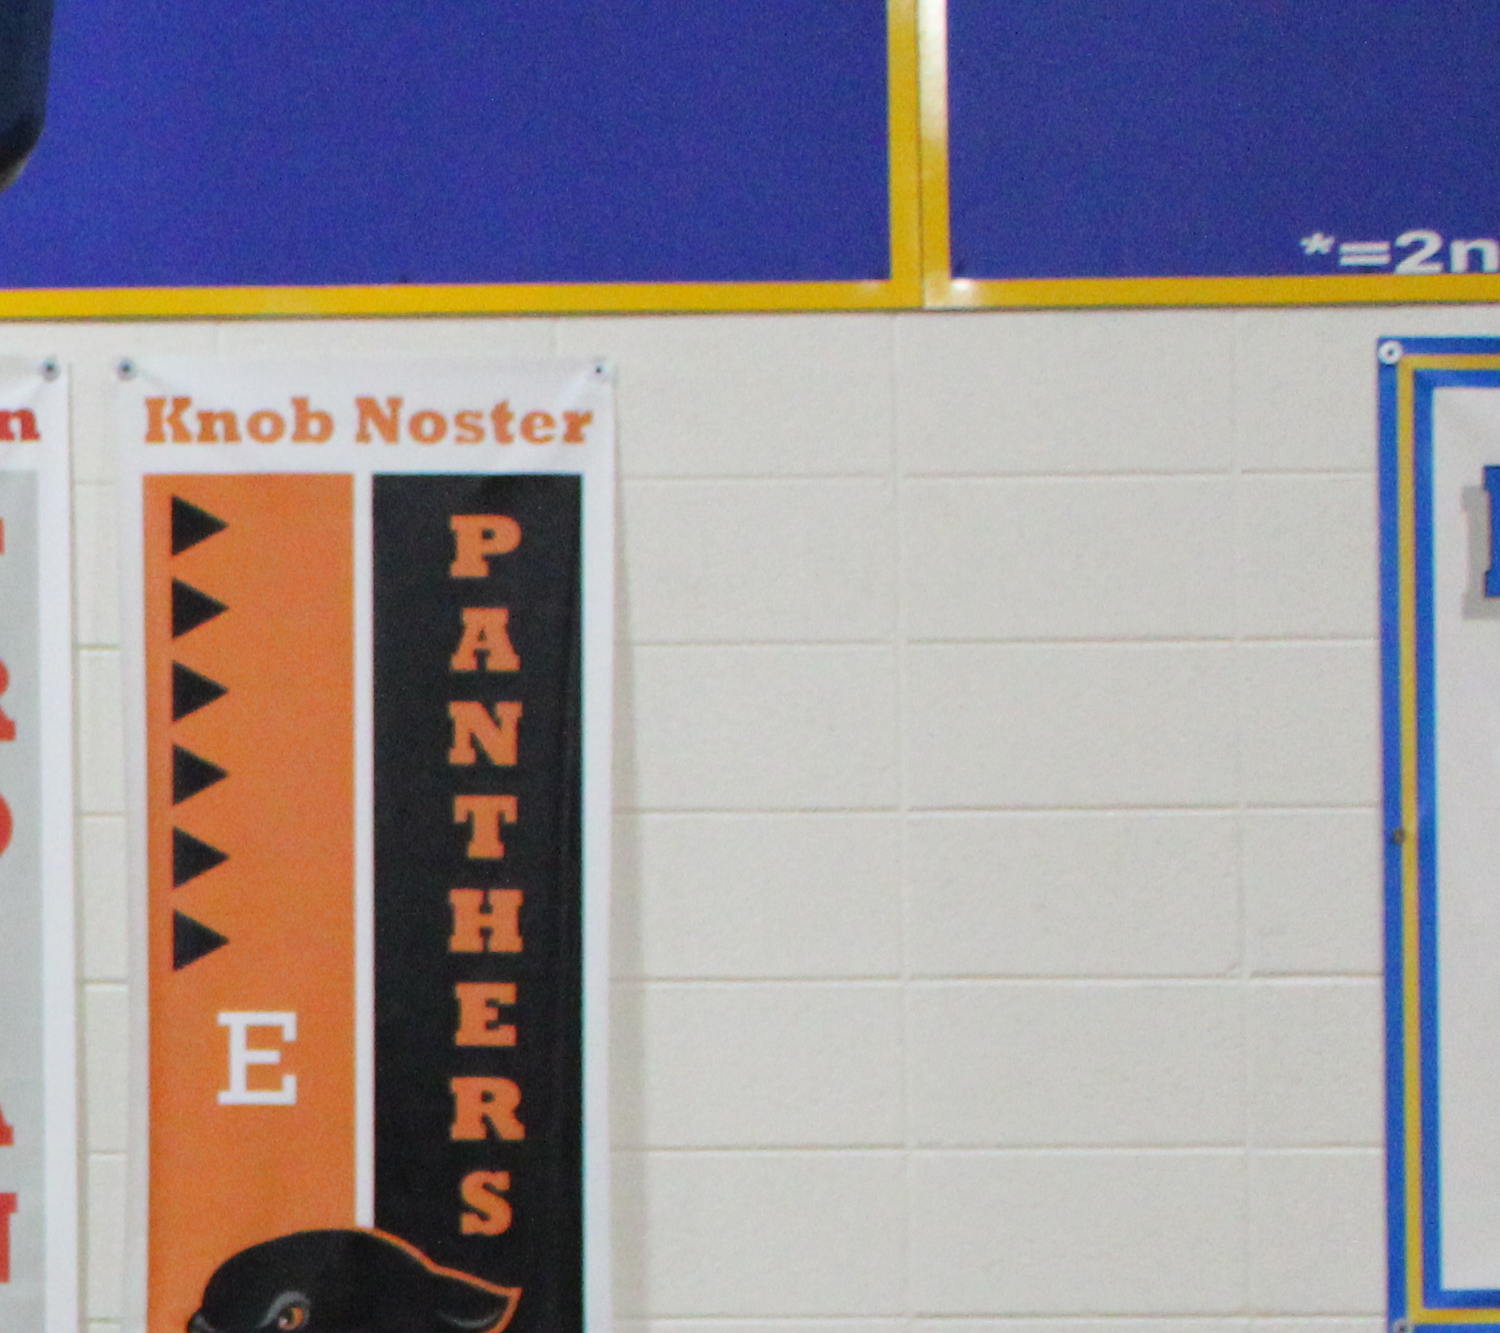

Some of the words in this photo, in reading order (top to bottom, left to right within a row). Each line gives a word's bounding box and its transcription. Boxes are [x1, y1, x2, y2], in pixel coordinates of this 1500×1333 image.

[142, 395, 336, 446] Knob
[353, 395, 595, 446] Noster
[446, 514, 526, 1237] PANTHERS
[216, 1010, 298, 1106] E
